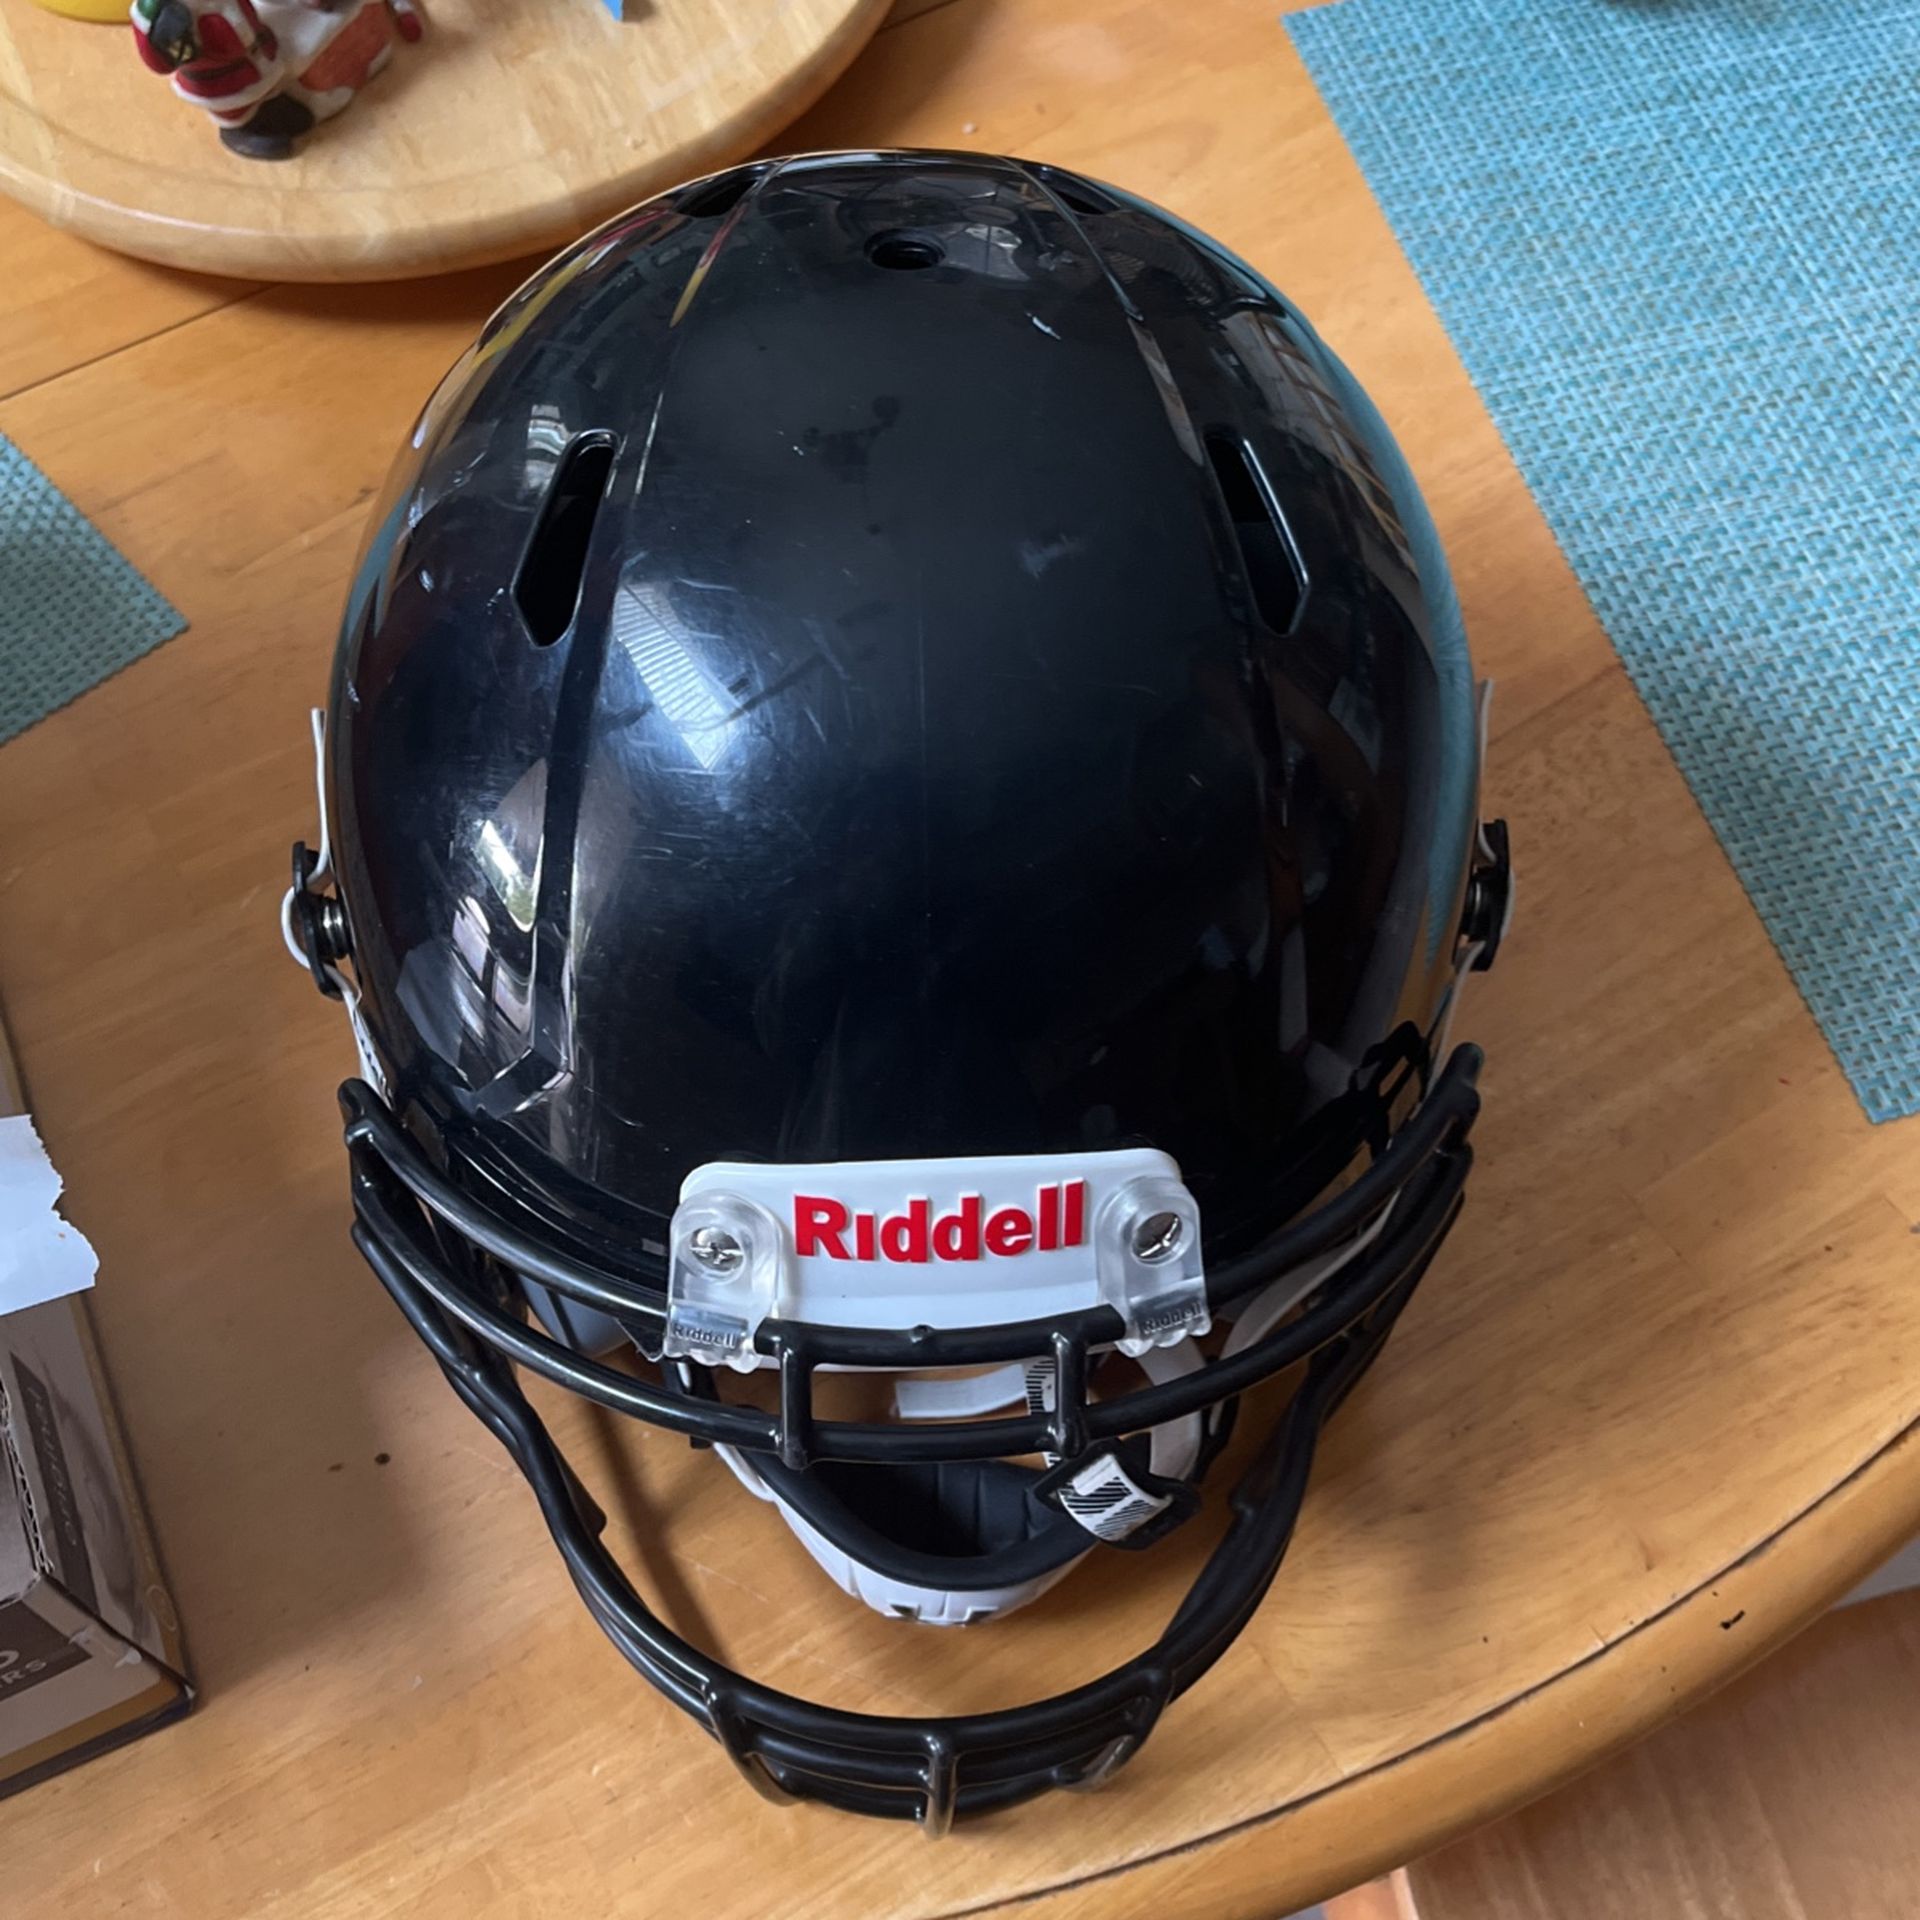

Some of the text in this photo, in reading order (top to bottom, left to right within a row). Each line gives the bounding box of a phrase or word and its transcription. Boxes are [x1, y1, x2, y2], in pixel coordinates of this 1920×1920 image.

[794, 1181, 1086, 1263] Riddell
[1145, 1302, 1201, 1335] Riddell
[674, 1324, 736, 1349] Riddell
[0, 1652, 47, 1686] RS
